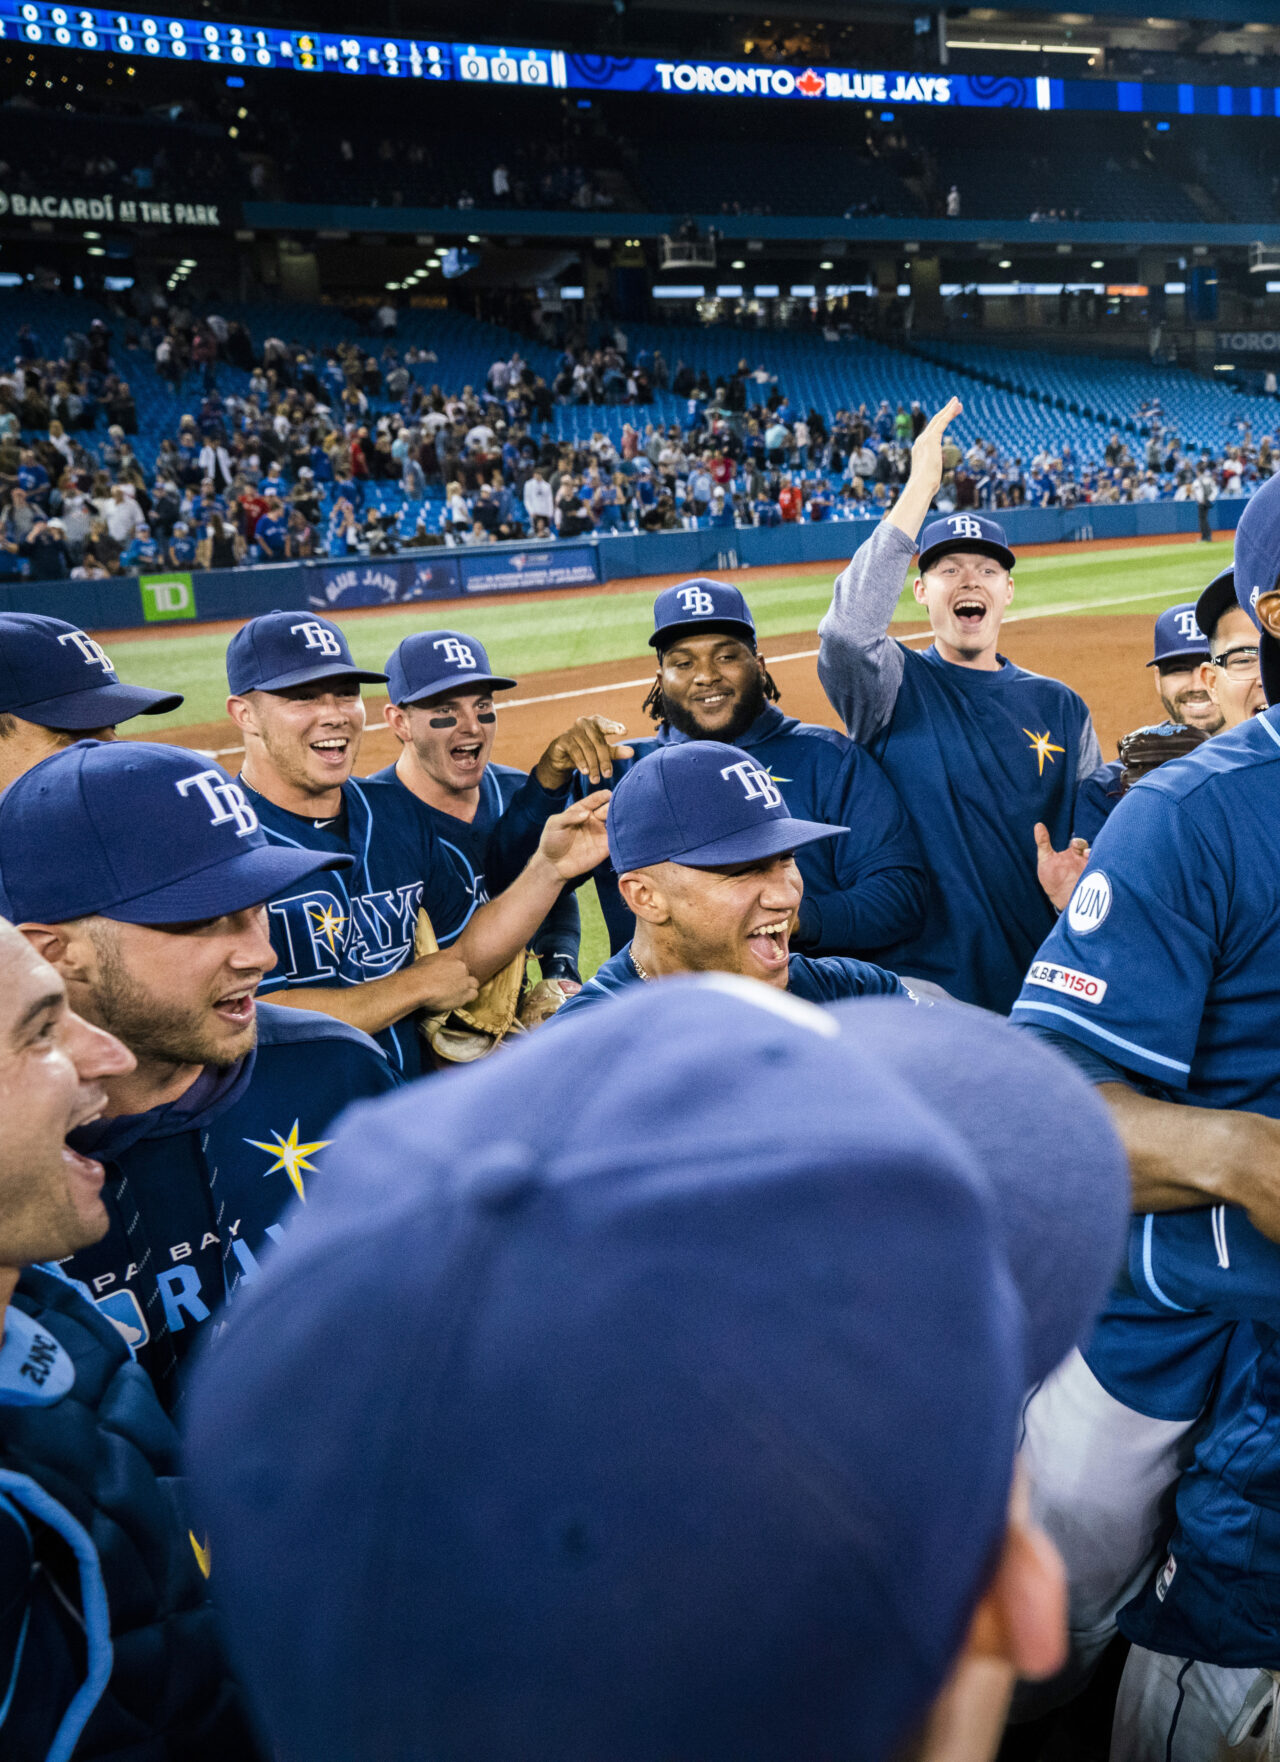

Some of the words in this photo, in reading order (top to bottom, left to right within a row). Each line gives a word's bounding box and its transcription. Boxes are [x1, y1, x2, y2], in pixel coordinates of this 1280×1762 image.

[655, 62, 796, 96] TORONTO
[825, 74, 887, 101] BLUE
[888, 76, 951, 103] JAYS
[139, 202, 172, 224] THE
[174, 203, 220, 226] PARK
[946, 514, 983, 539] TB
[144, 582, 189, 612] TD
[362, 568, 399, 601] JAYS
[676, 586, 715, 616] TB
[57, 630, 115, 674] TB
[290, 621, 341, 657] TB
[433, 637, 477, 669] TB
[719, 759, 782, 810] TB
[175, 769, 260, 839] TB
[1075, 885, 1108, 919] VJN
[1069, 974, 1099, 996] 150
[169, 1219, 242, 1262] BAY
